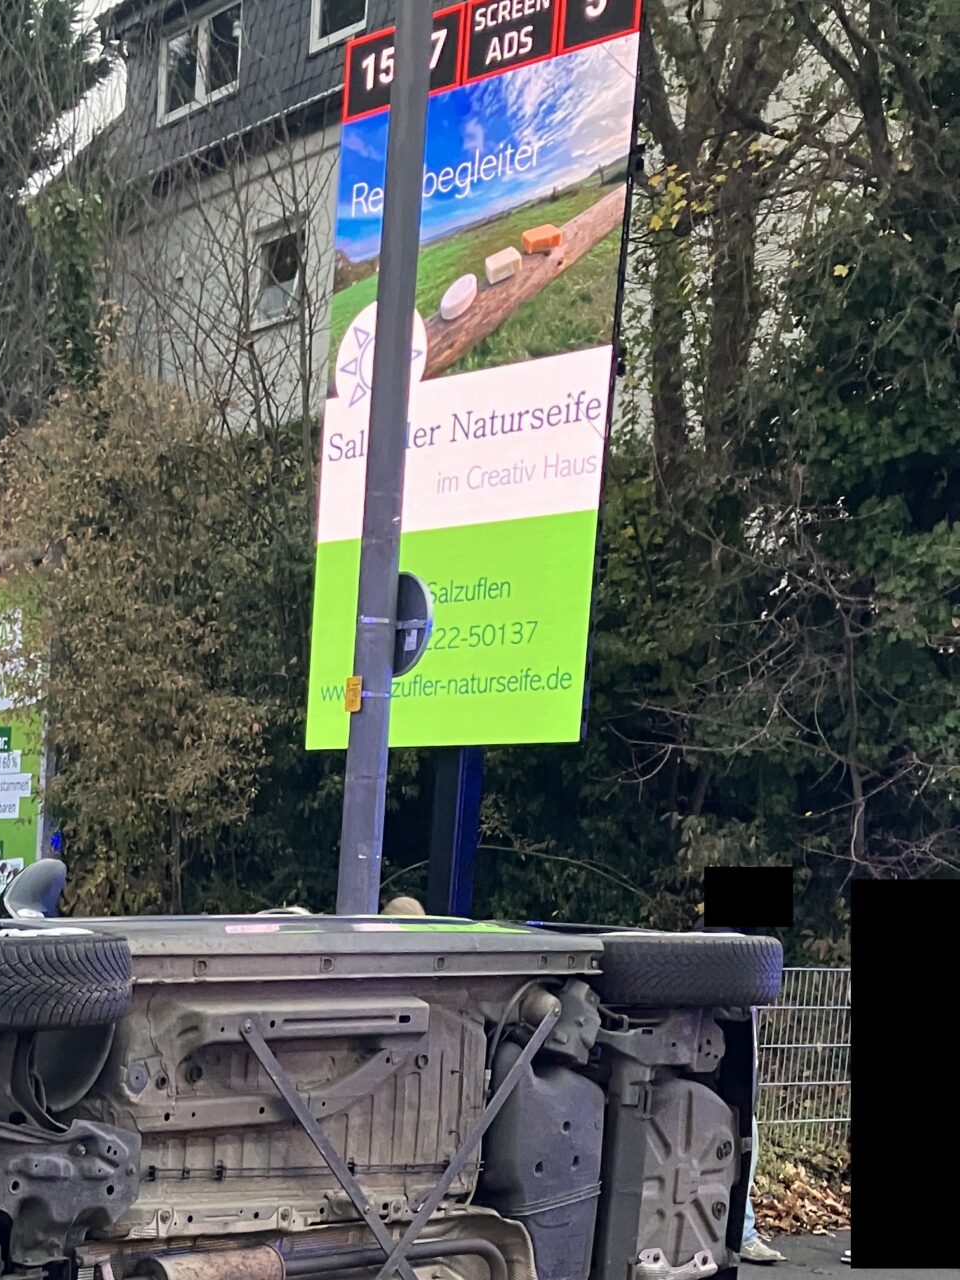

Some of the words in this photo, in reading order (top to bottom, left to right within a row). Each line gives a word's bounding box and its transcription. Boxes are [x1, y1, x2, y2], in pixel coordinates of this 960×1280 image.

[486, 26, 533, 66] ADS
[352, 140, 544, 218] Rebegleiter
[328, 421, 441, 461] Saller
[450, 390, 602, 444] Naturseife
[437, 471, 459, 493] im
[467, 460, 536, 491] Creativ
[543, 453, 597, 479] Haus
[427, 577, 511, 605] Salzuflen
[0, 780, 29, 792] stammen
